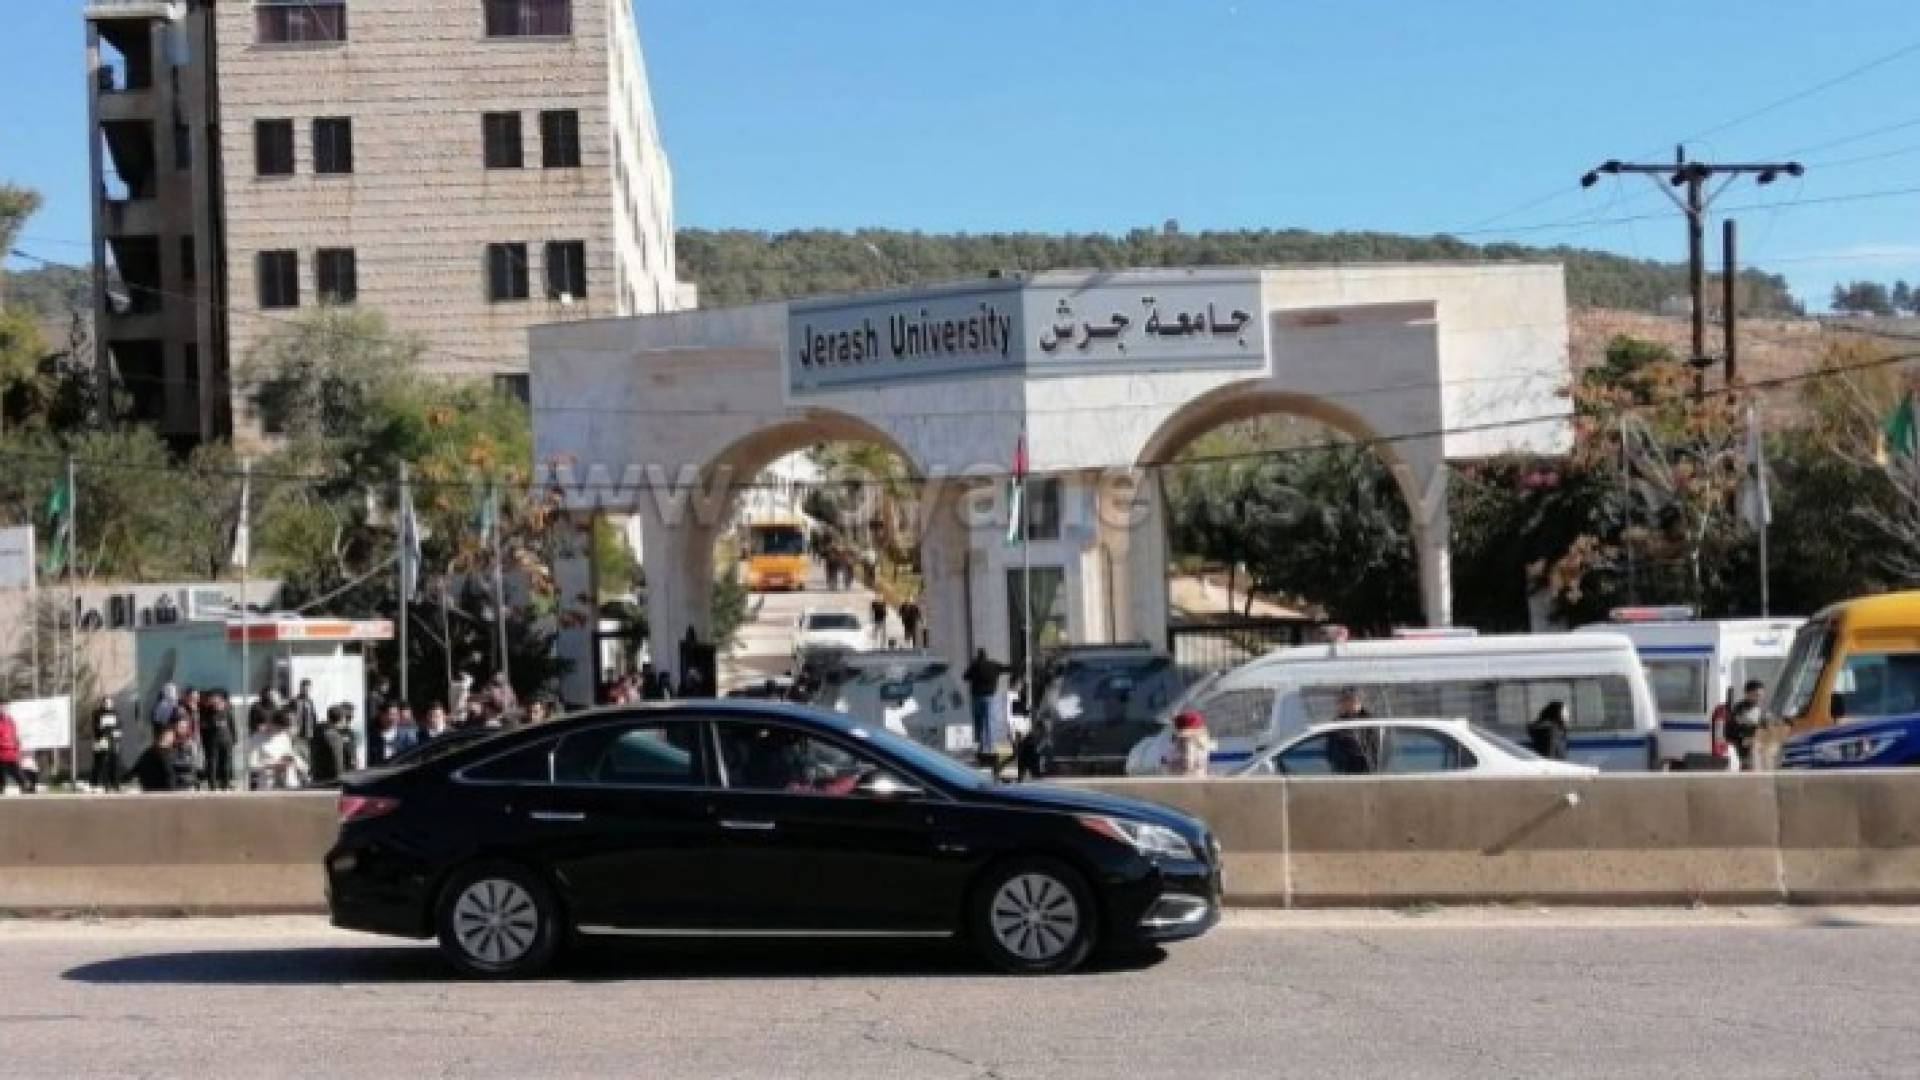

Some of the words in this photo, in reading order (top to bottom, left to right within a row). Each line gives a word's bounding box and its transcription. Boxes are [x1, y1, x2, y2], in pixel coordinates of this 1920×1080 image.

[800, 318, 878, 368] Jerash
[889, 302, 1011, 360] University
[1039, 298, 1130, 352] جرش
[1141, 296, 1251, 347] جامعة
